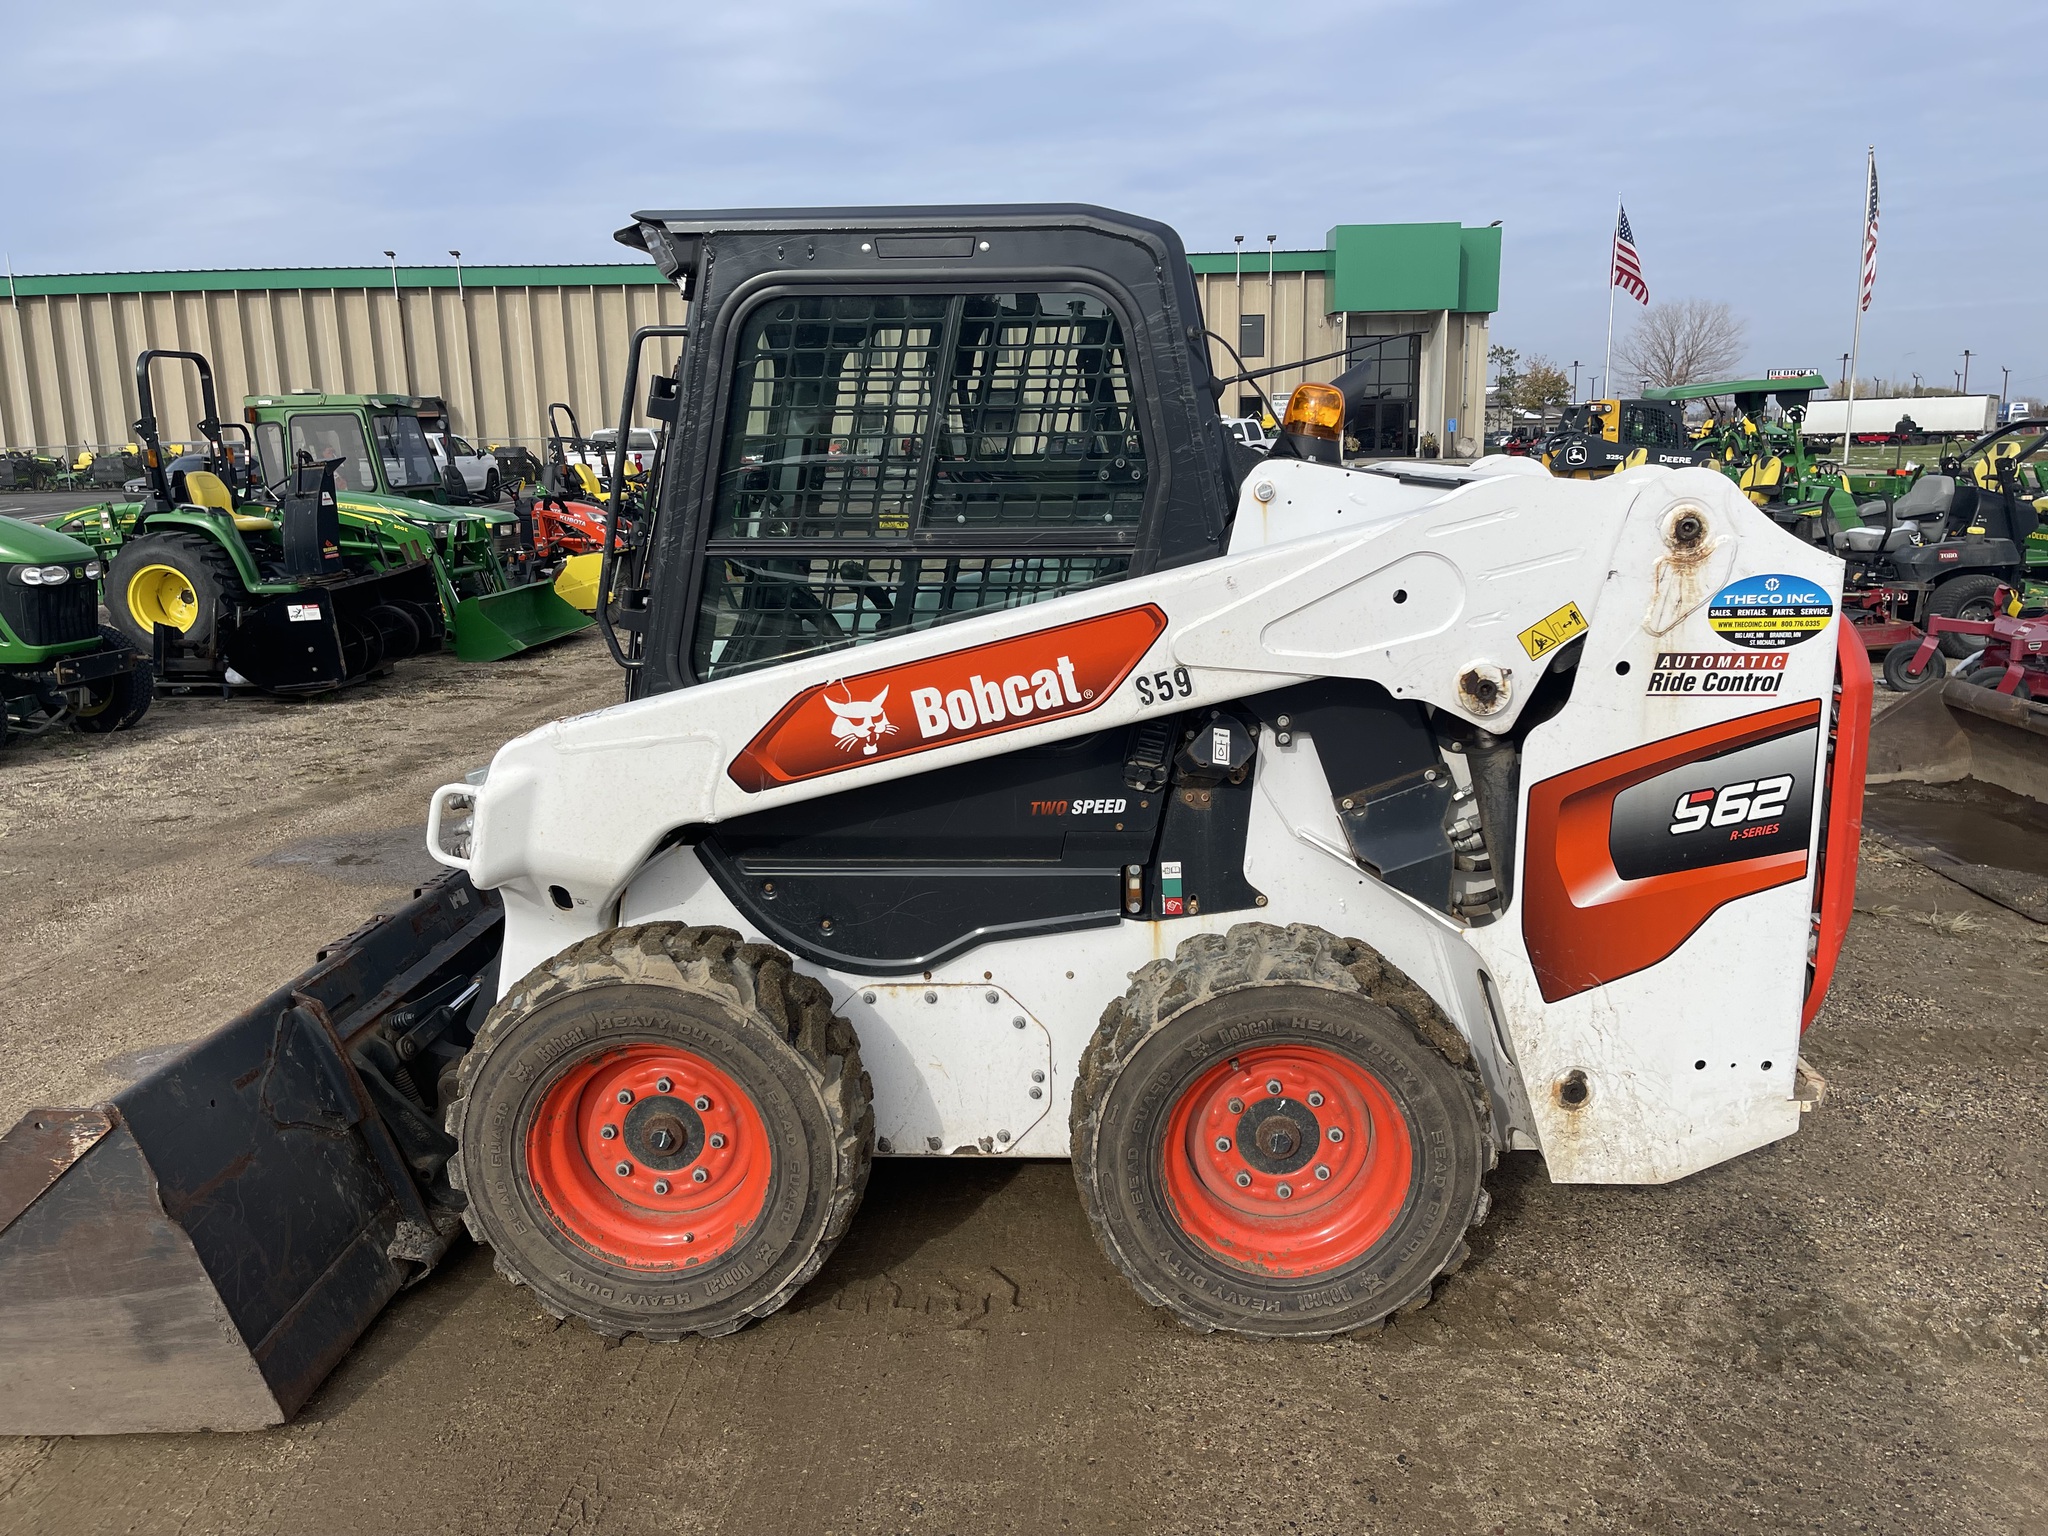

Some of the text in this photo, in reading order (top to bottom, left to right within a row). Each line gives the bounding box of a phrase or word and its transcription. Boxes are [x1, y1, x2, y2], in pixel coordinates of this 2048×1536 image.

[1659, 454, 1692, 464] DEERE
[560, 514, 586, 527] KUBOTA
[1710, 607, 1830, 617] SALES. RENTALS. PARTS. SERVICE.
[1723, 593, 1820, 605] THECO INC.
[1718, 620, 1821, 628] WWW.THECOINC.COM 800.776.0335
[1659, 655, 1783, 669] AUTOMATIC
[910, 655, 1083, 739] Bobcat
[1135, 667, 1194, 706] S59
[1647, 672, 1784, 692] Ride Control
[1031, 798, 1127, 816] TWO SPEED
[1668, 774, 1795, 836] S62
[1729, 823, 1780, 841] R-SERIES
[535, 1025, 588, 1064] Bobcat
[600, 1015, 671, 1031] HEAVY
[677, 1022, 736, 1055] DUTY
[1217, 1016, 1419, 1085] Bobcat HEAVY DUTY
[1127, 1071, 1172, 1206] BEAD GUARD
[490, 1101, 529, 1236] BEAD GUARD
[767, 1089, 801, 1226] BEAD GUARD
[1399, 1129, 1447, 1263] BEAD GUARD
[558, 1269, 615, 1300] DUTY
[704, 1260, 753, 1297] Bobcat
[1159, 1249, 1353, 1313] Bobcat HEAVY DUTY
[621, 1291, 692, 1307] HEAVY
